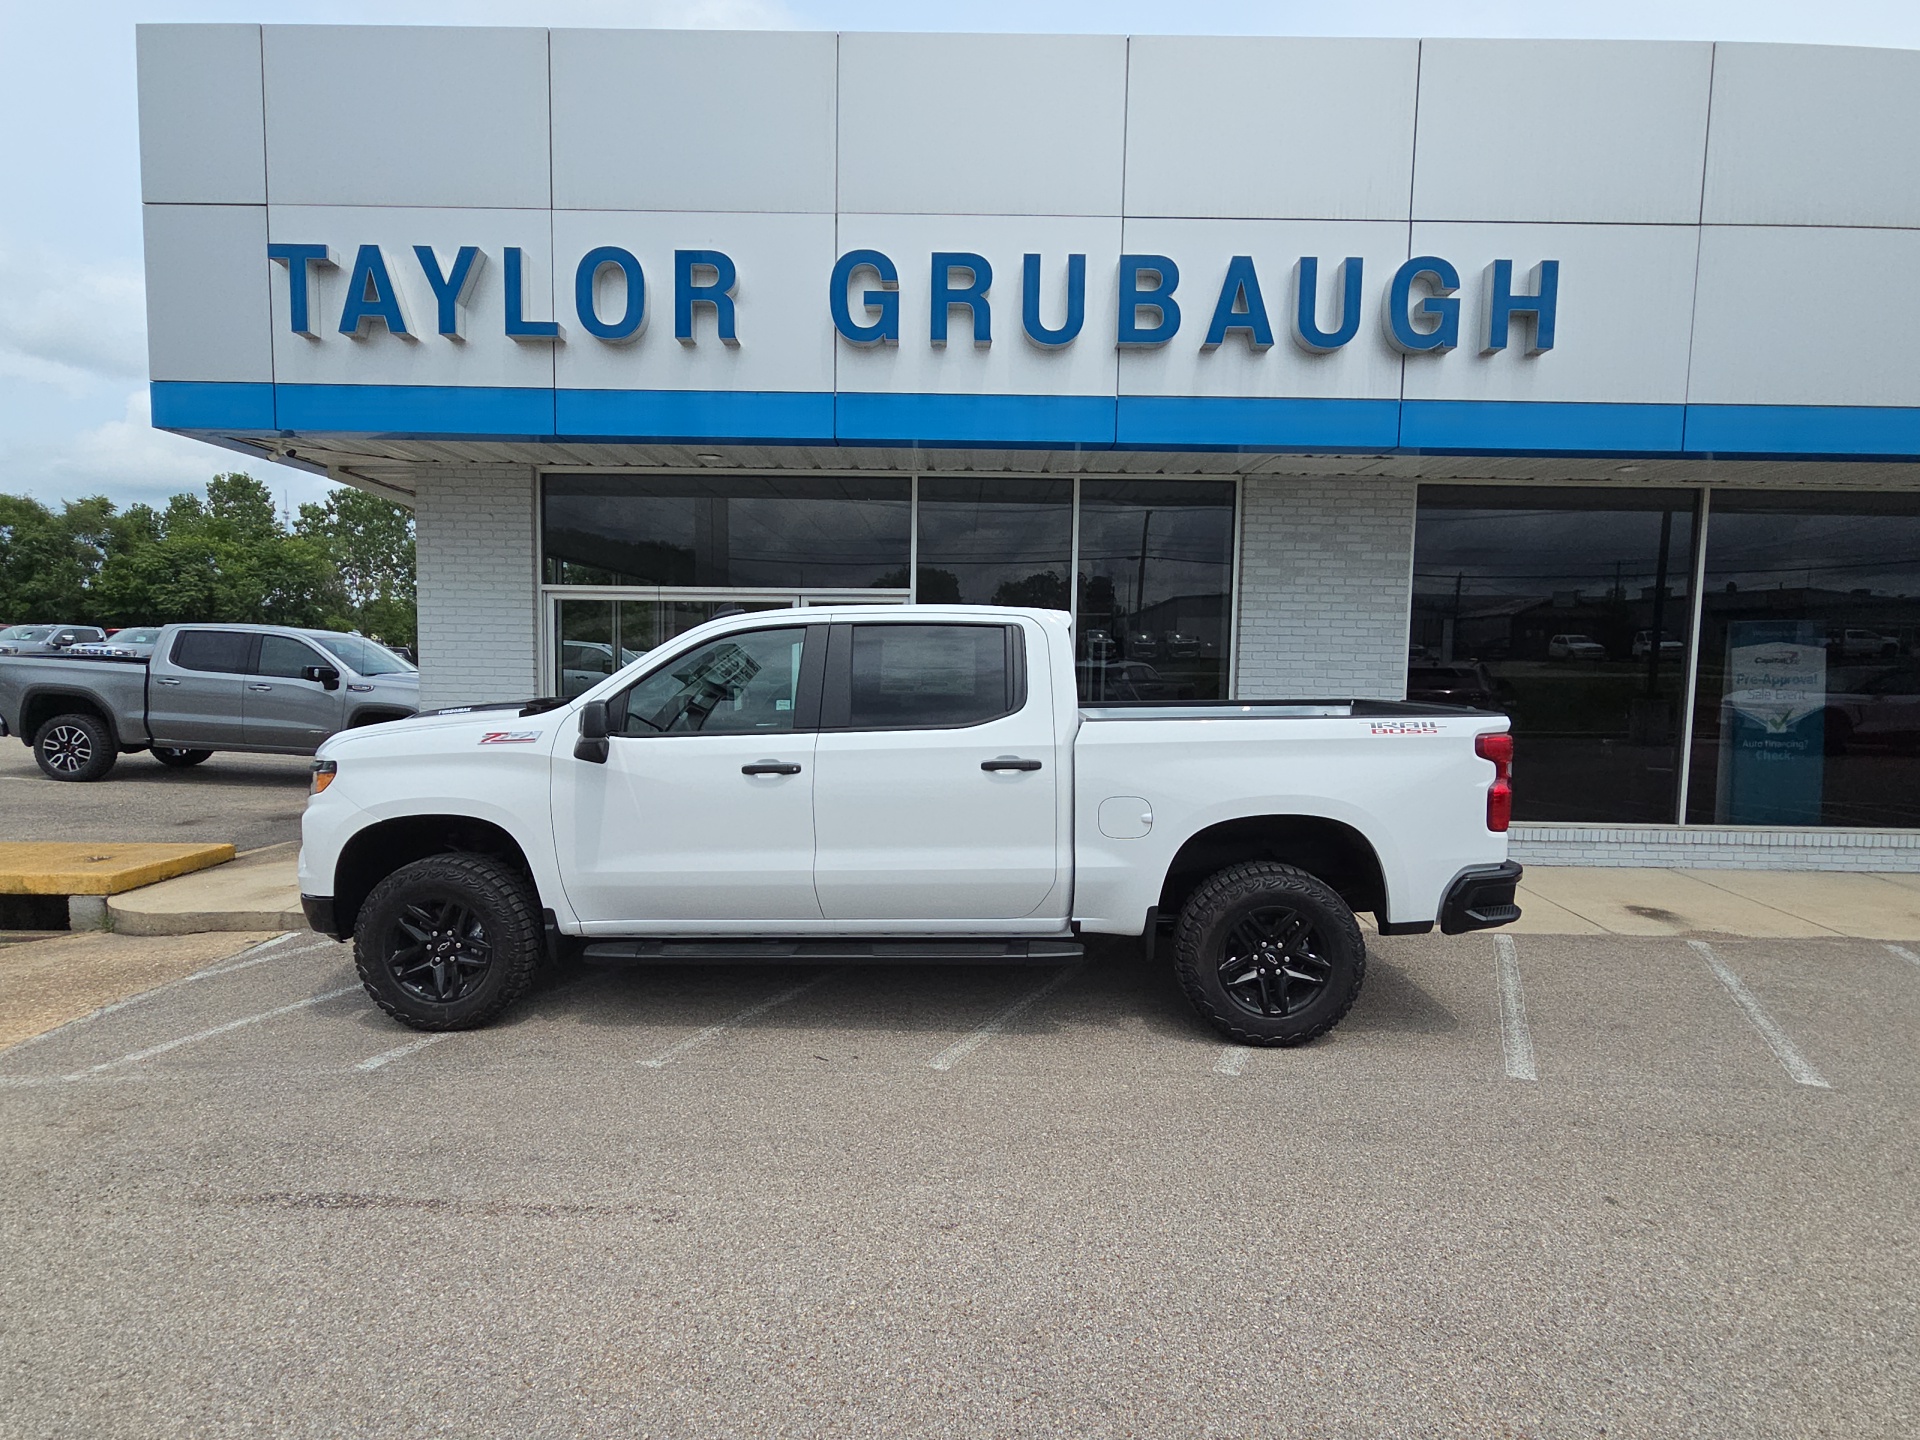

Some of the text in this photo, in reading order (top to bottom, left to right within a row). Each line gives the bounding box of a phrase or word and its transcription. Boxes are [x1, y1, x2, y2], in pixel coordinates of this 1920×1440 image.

[267, 243, 1559, 354] TAYLOR GRUBAUGH
[1736, 673, 1818, 687] Pre-Approval
[1747, 689, 1807, 700] Sale Event
